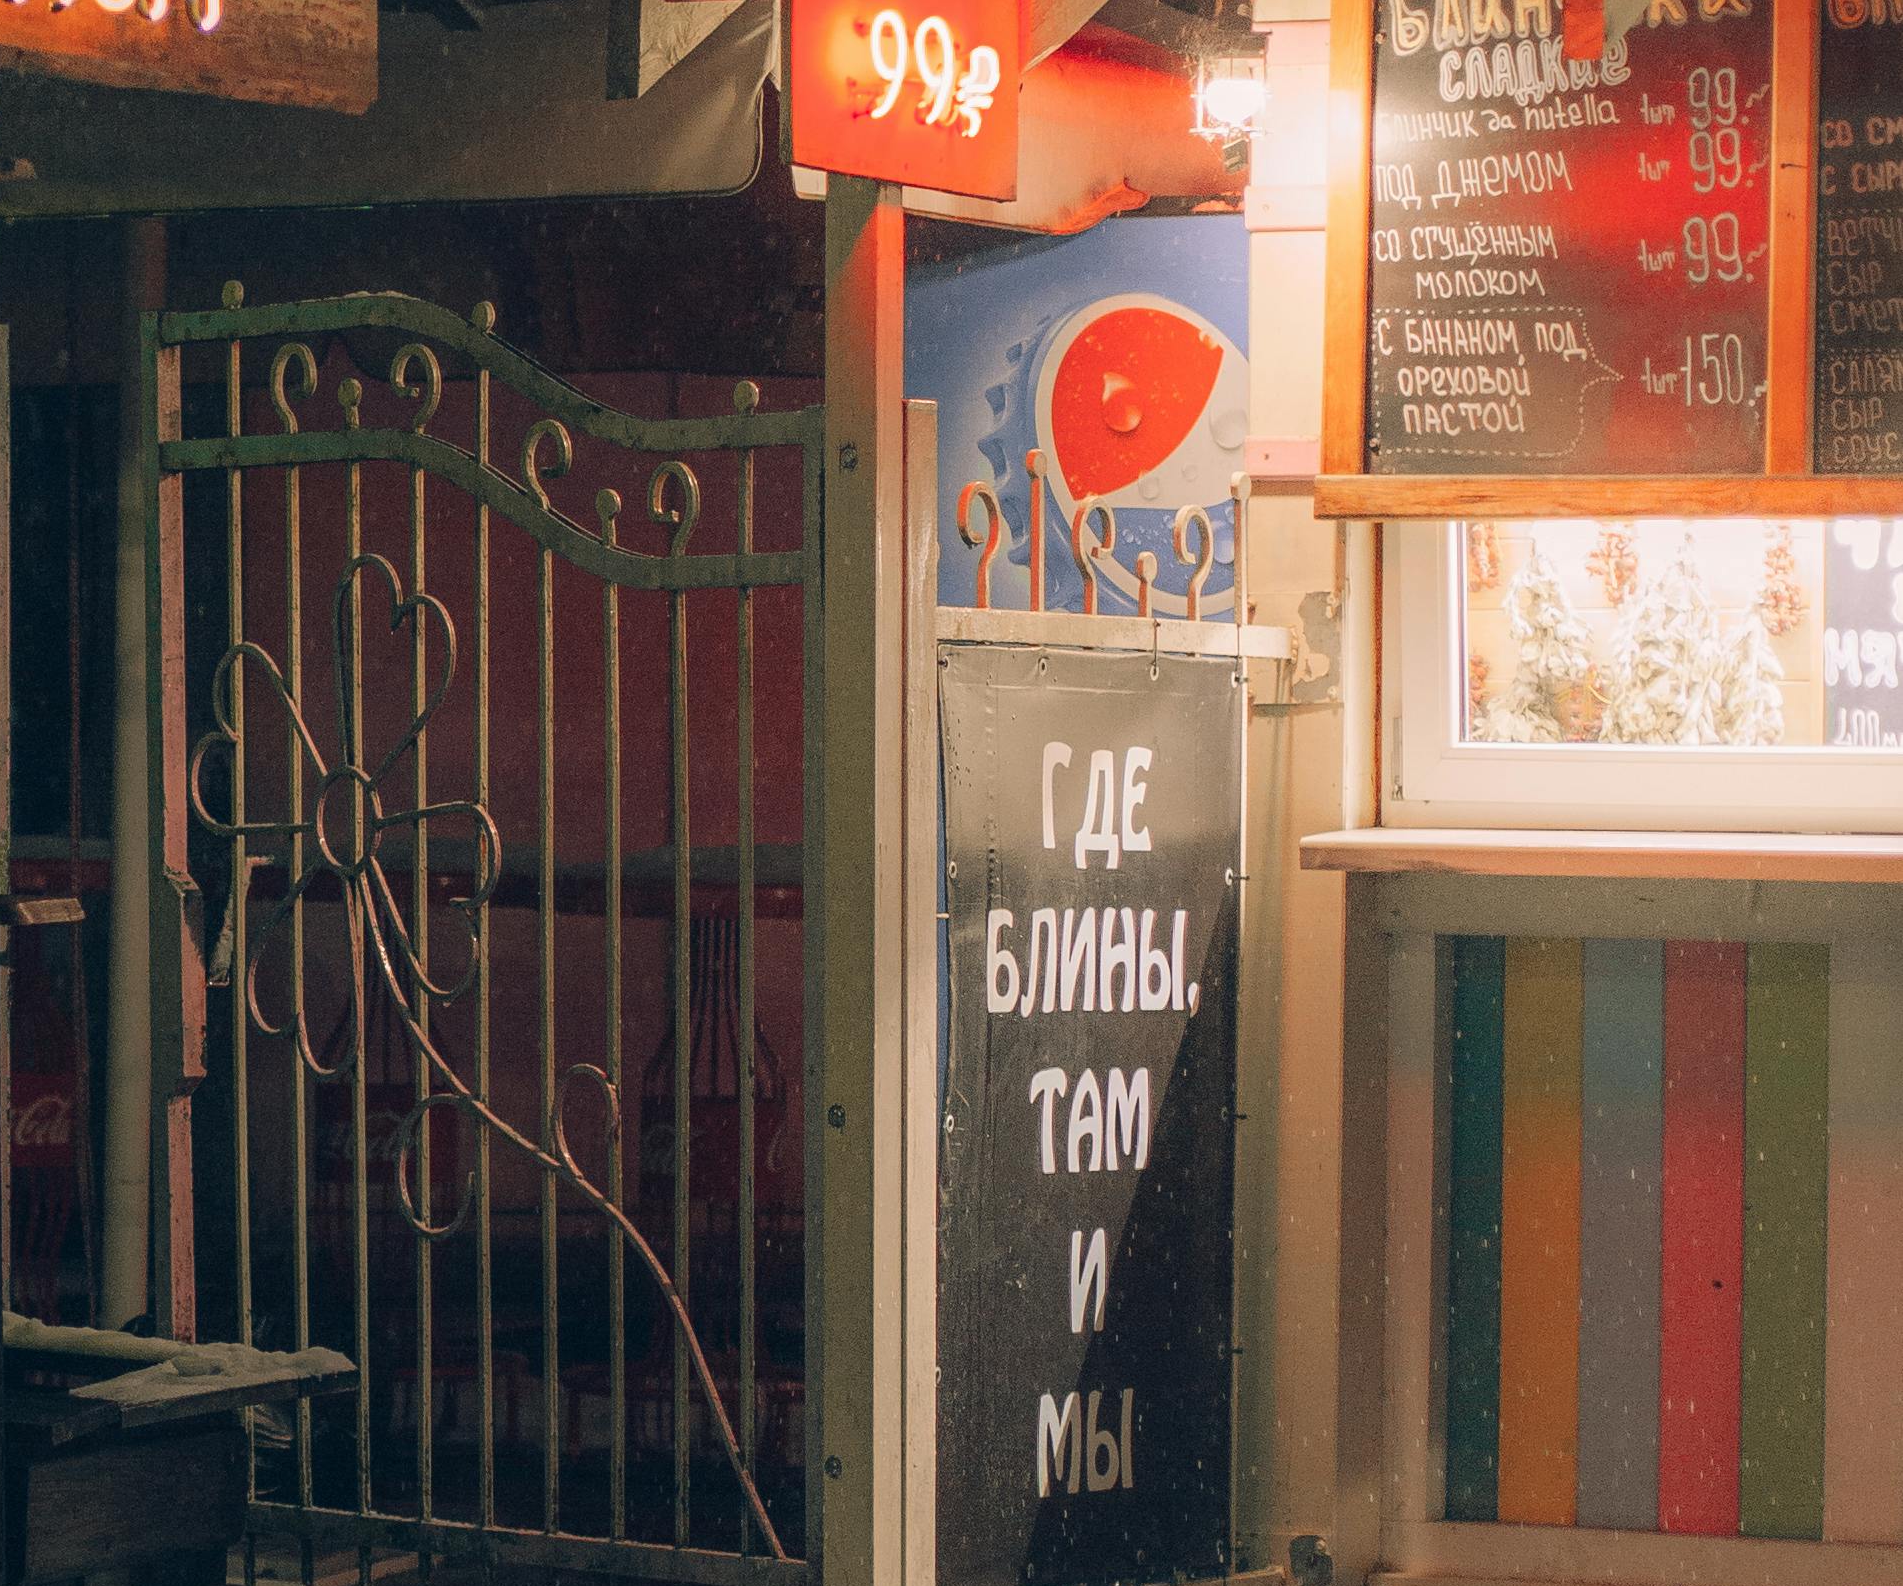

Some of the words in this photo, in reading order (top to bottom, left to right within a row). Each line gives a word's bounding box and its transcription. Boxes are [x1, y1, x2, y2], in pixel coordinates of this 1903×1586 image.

[1525, 93, 1620, 132] nutella
[1415, 268, 1545, 302] МОЛОКОМ
[1406, 320, 1519, 357] БАНАНОМ
[1535, 322, 1587, 362] ПОД
[1403, 396, 1525, 436] ПАСТОЙ
[1042, 742, 1152, 870] ГДЕ
[986, 906, 1200, 1018] БЛИНЫ,
[1029, 1066, 1149, 1175] ТАМ
[1070, 1227, 1109, 1333] И
[1038, 1388, 1134, 1498] МЫ
